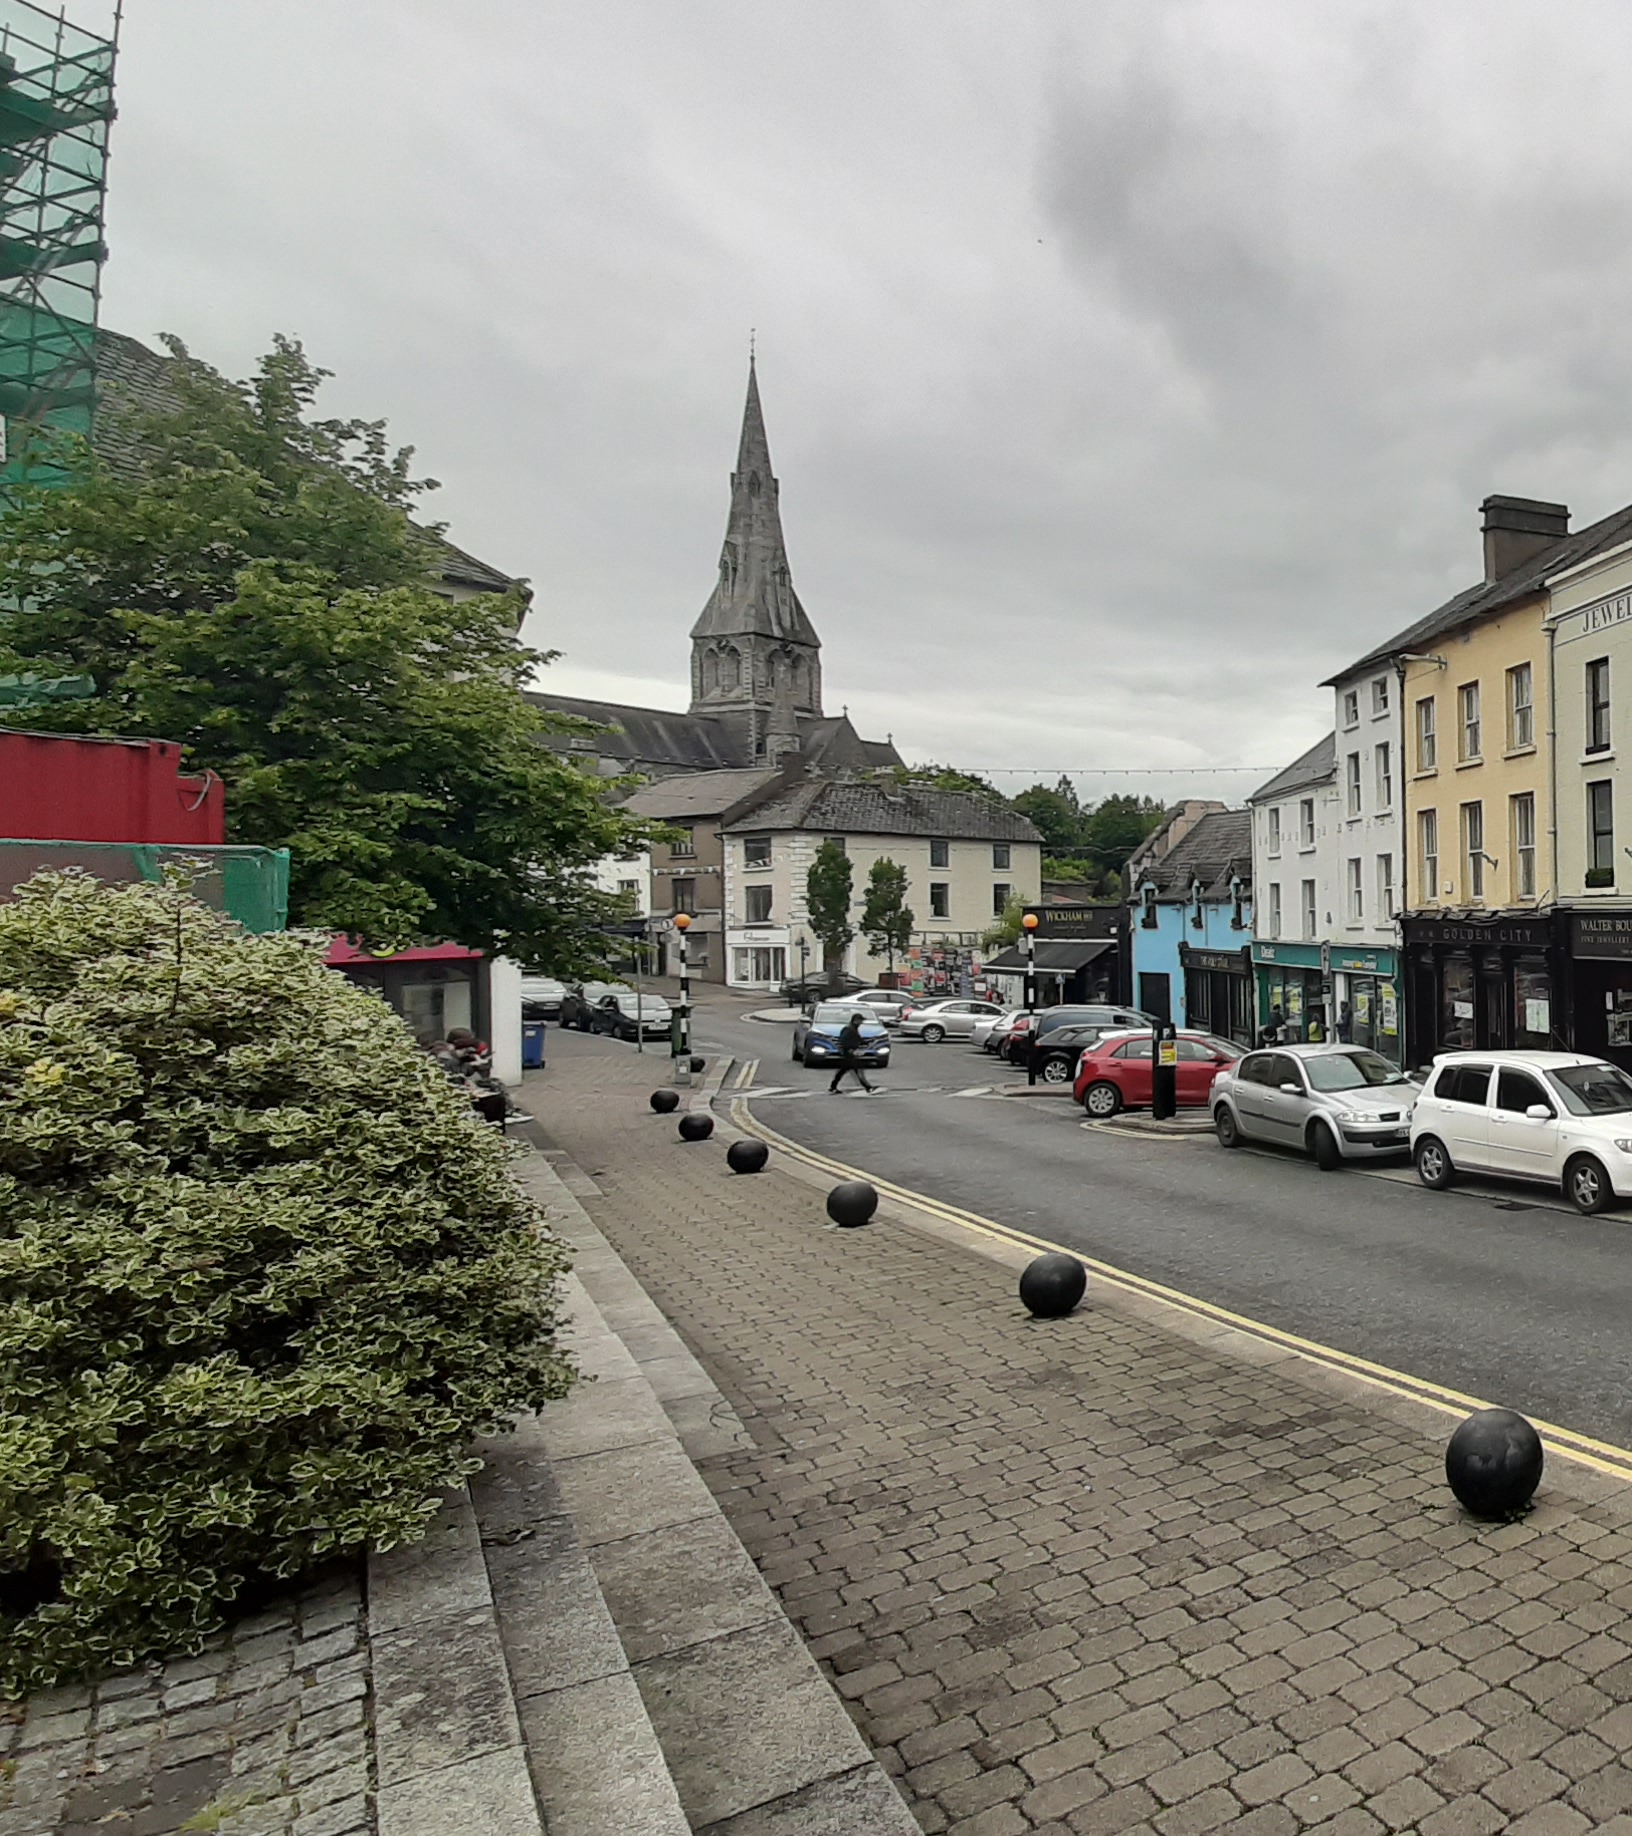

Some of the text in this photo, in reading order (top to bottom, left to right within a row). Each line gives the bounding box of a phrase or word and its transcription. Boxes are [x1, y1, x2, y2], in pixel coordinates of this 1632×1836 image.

[1580, 920, 1612, 932] WALTER
[1443, 928, 1491, 940] GOLDEN
[1500, 929, 1532, 941] CITY
